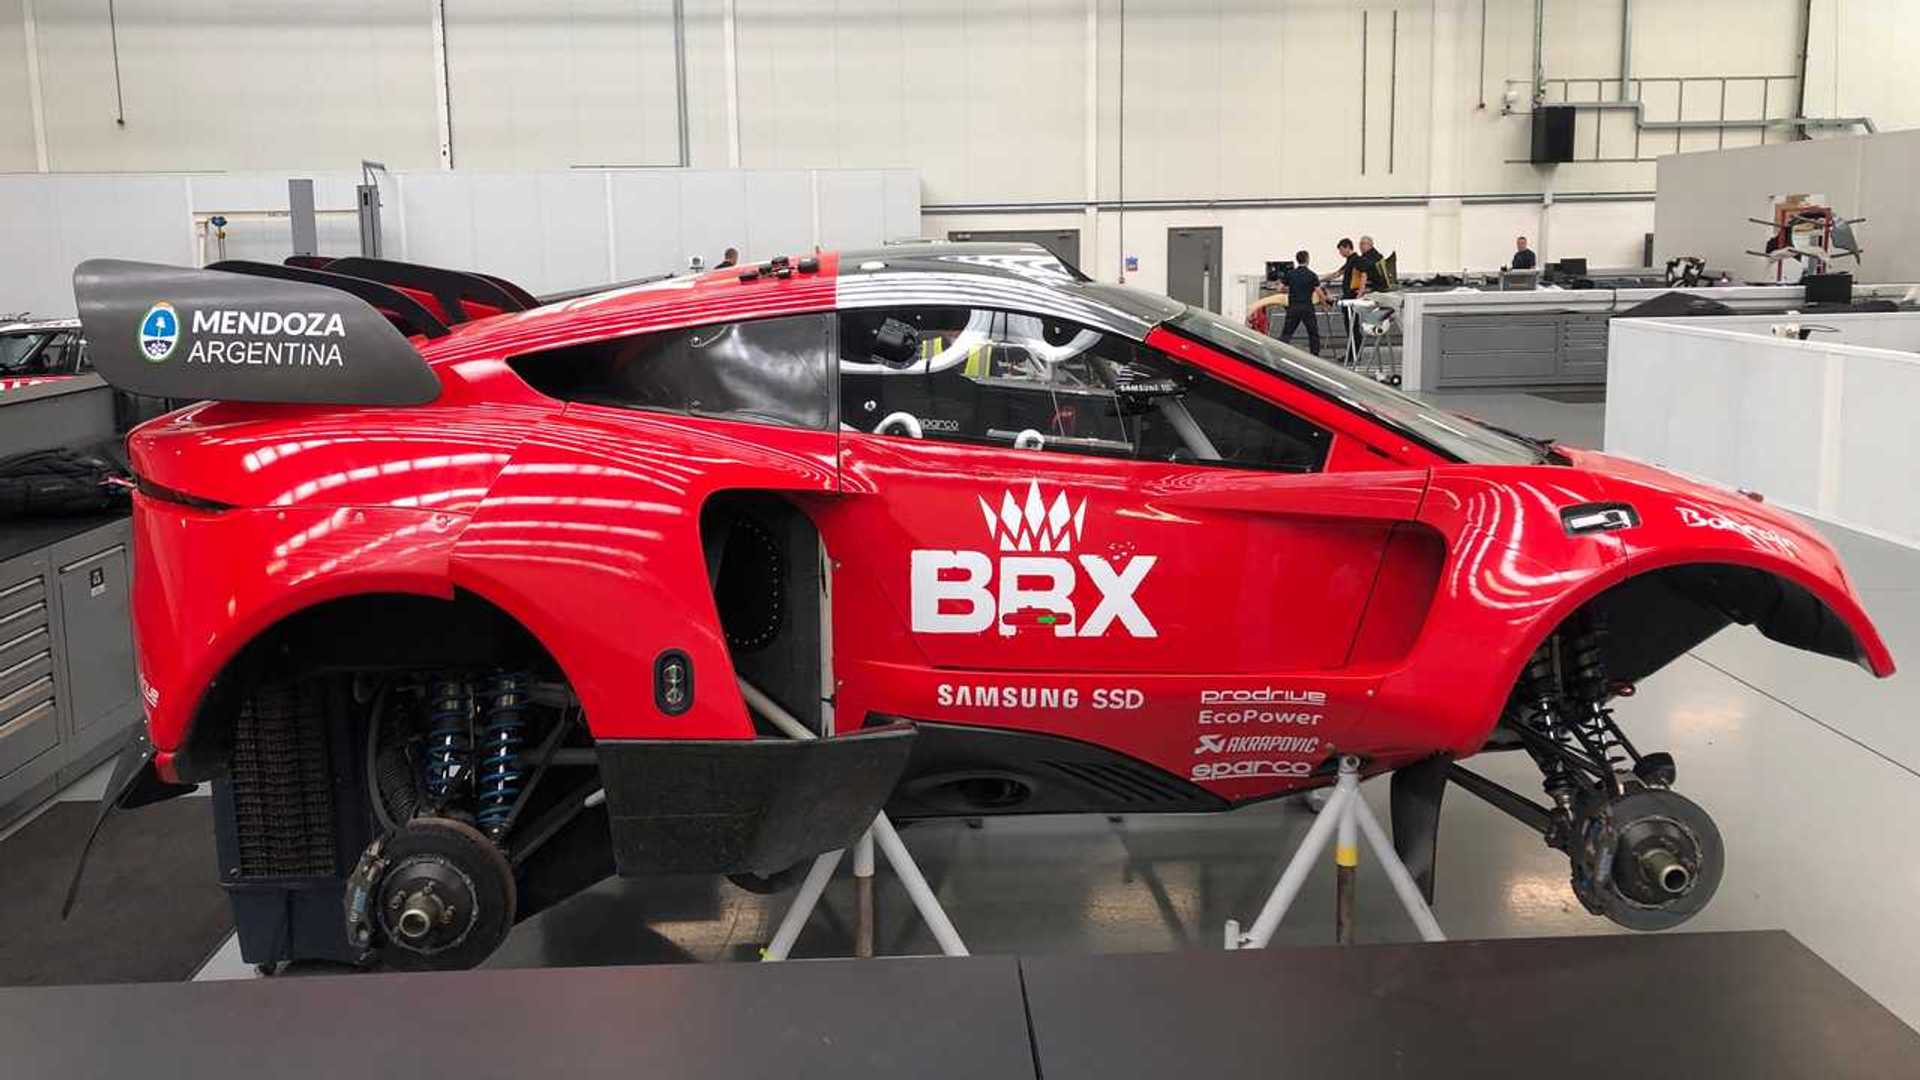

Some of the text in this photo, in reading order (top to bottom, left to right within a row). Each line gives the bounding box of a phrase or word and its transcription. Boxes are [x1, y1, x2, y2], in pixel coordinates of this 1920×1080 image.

[192, 310, 345, 337] MENDOZA
[187, 340, 344, 366] ARGENTINA
[920, 418, 960, 432] parco
[910, 549, 1158, 638] BRX
[937, 684, 1144, 709] SAMSUNG SSD
[1201, 685, 1327, 705] prodrive
[1198, 709, 1324, 725] EcoPower
[1191, 760, 1312, 779] sparco
